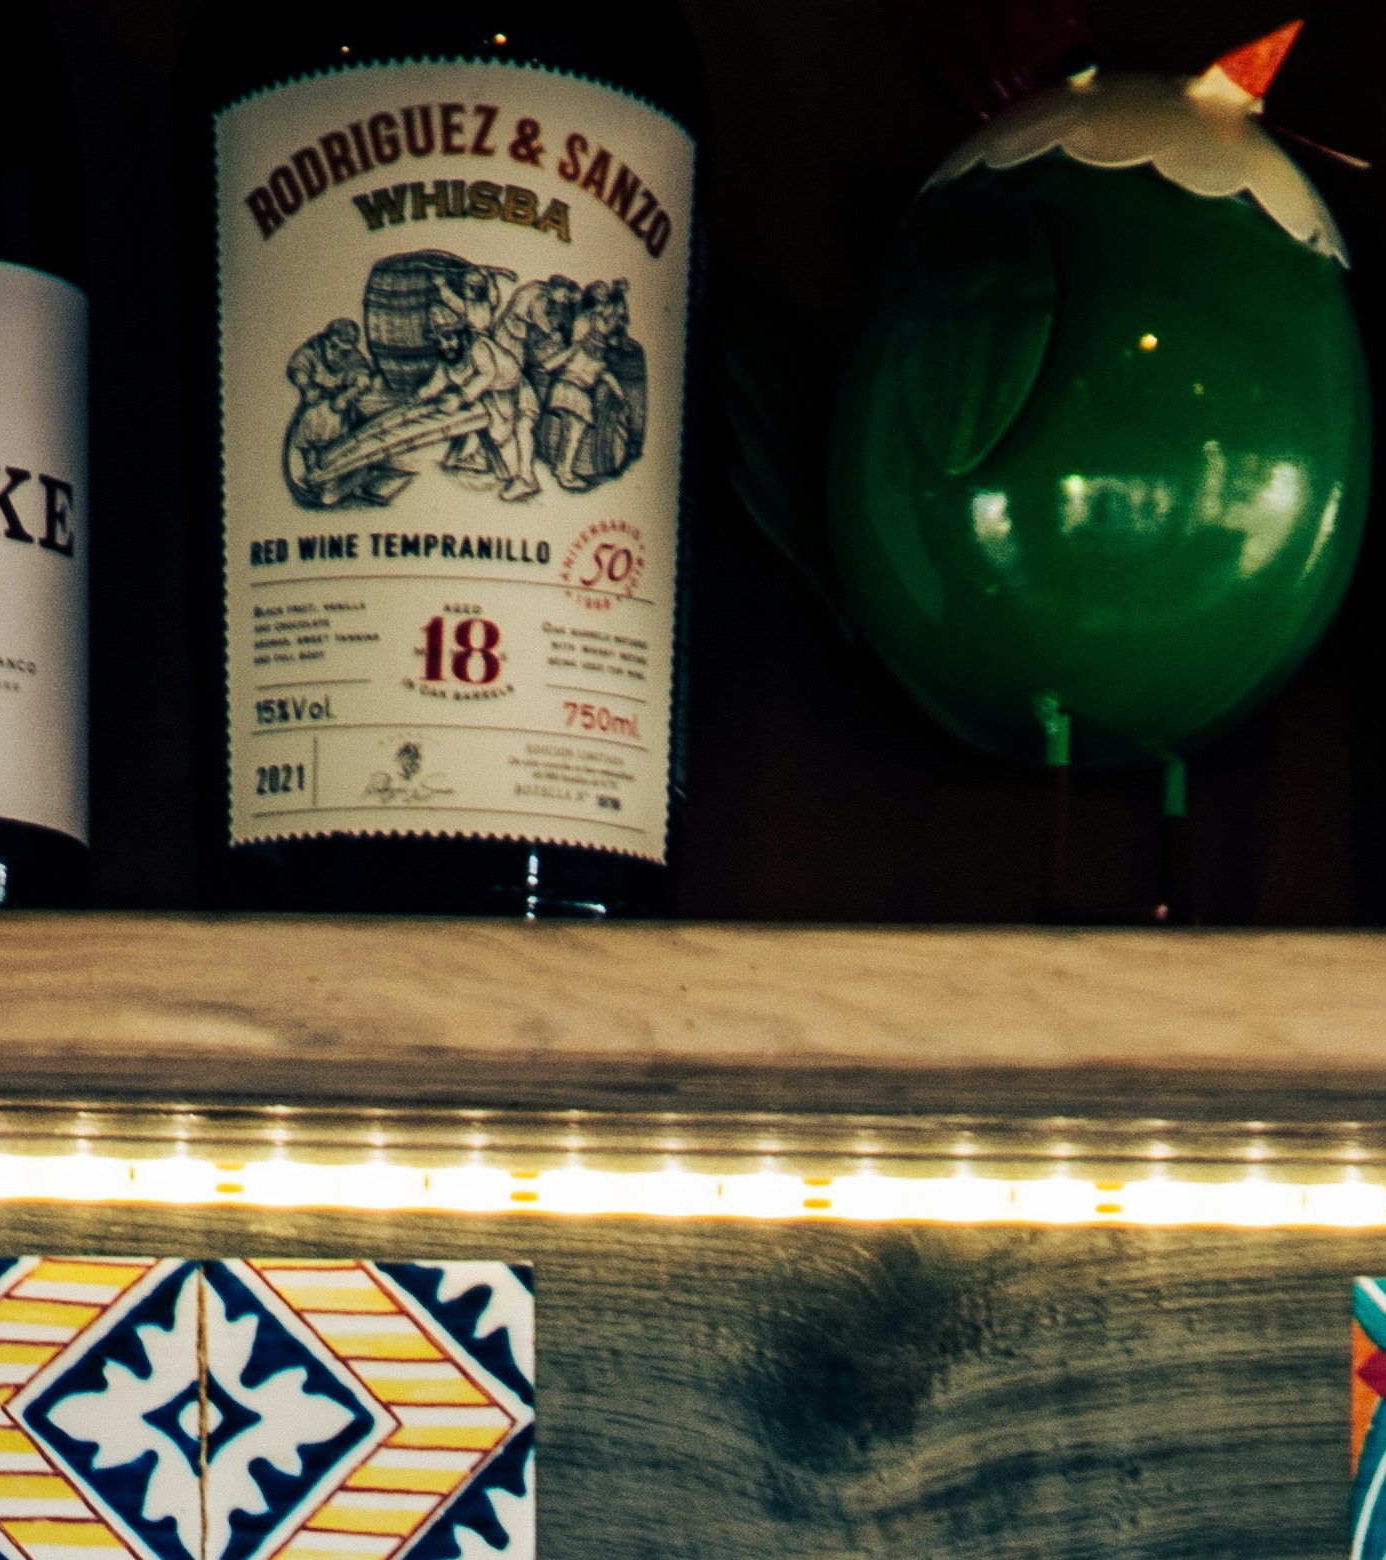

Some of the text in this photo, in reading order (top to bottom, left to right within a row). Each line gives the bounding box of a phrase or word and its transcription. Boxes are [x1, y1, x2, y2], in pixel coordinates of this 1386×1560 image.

[246, 102, 673, 259] RODRIGUEZ & SANZO
[353, 178, 573, 244] WHISBA
[250, 533, 551, 567] RED WINE TEMPRANILLO
[580, 543, 633, 587] 50
[420, 615, 501, 684] 18
[256, 762, 305, 796] 2021
